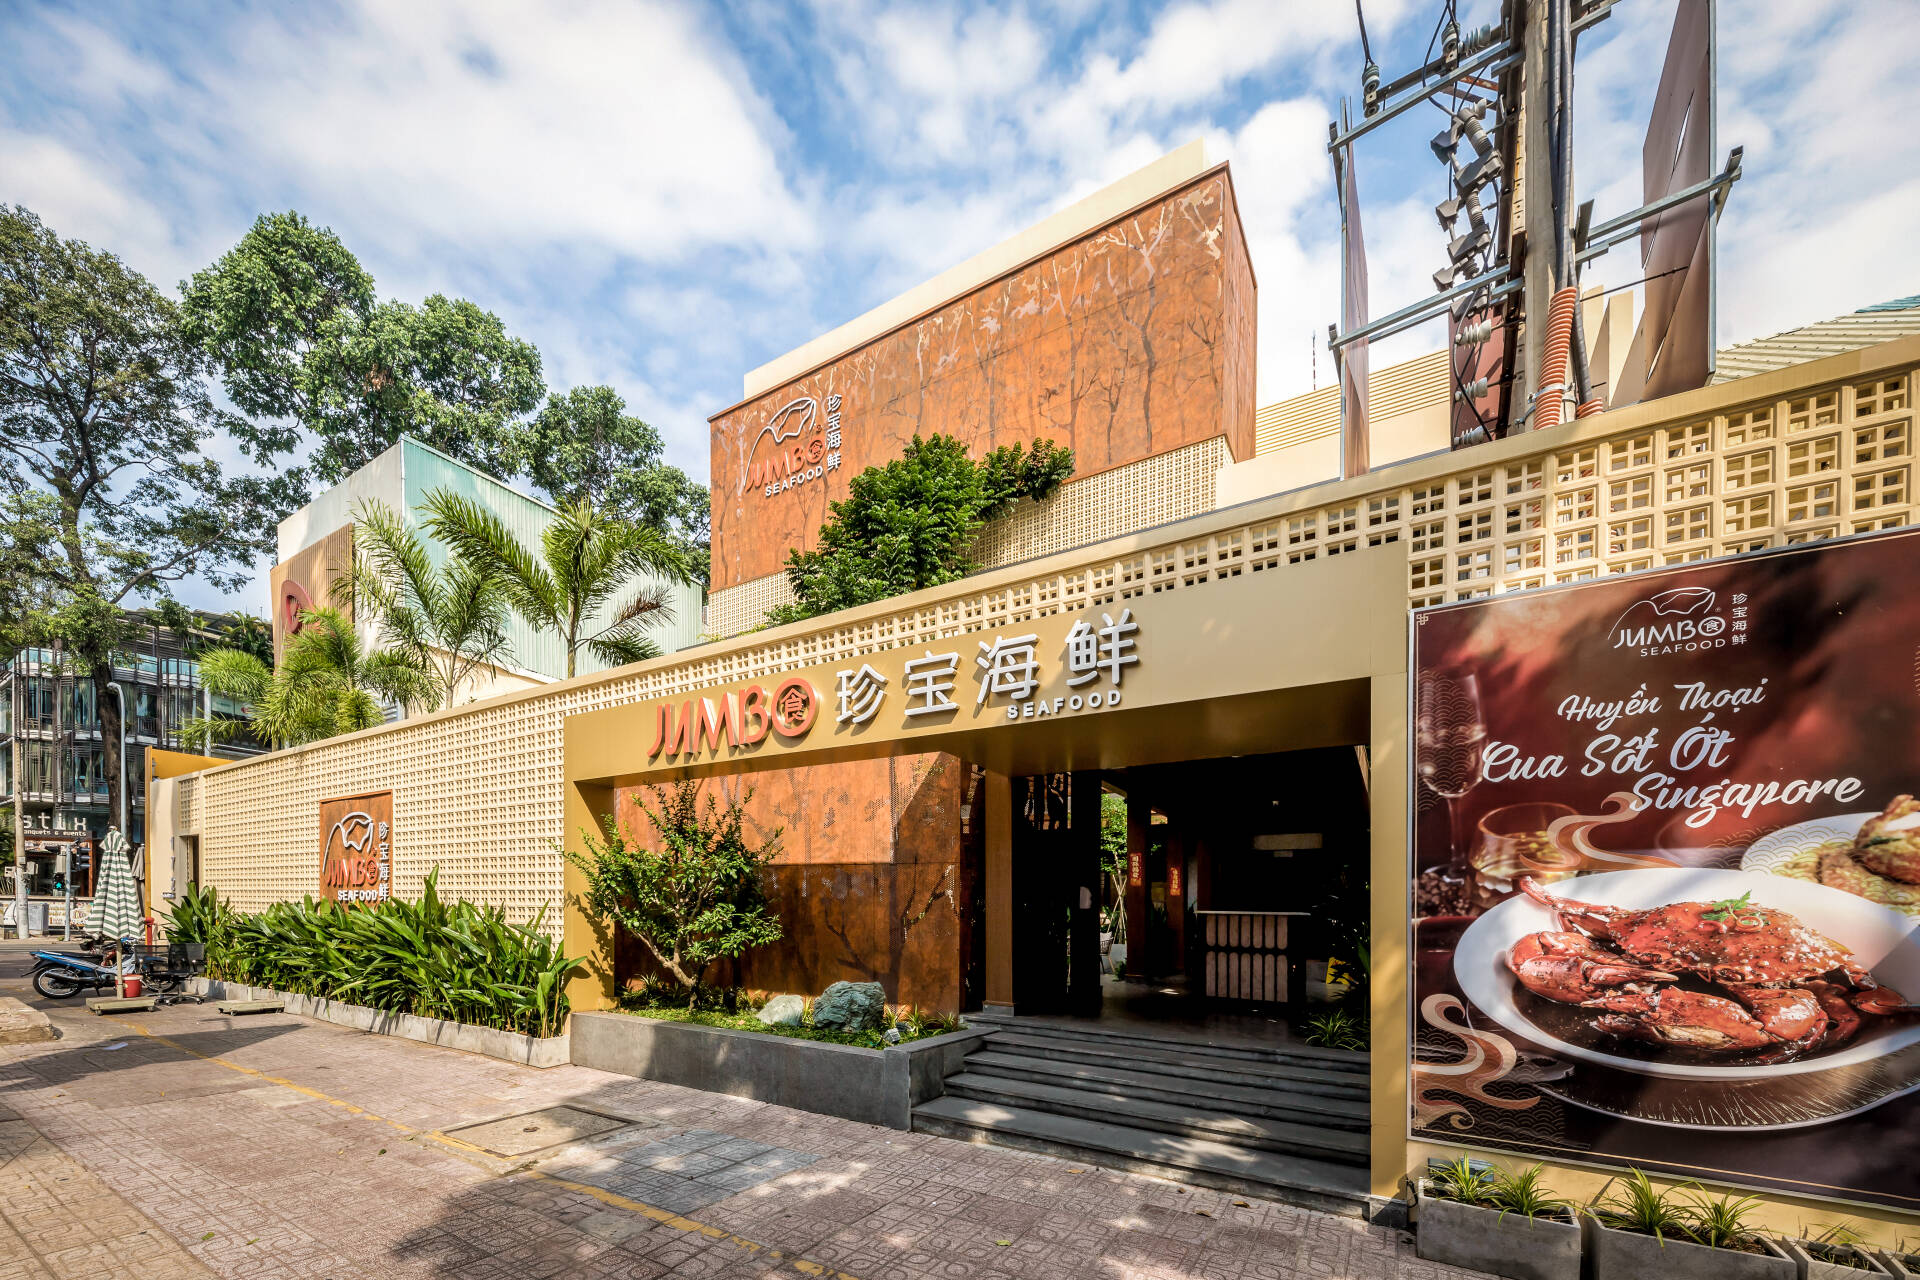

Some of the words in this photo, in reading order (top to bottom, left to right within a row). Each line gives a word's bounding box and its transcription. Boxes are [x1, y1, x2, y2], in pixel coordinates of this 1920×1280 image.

[827, 394, 843, 472] 珍宝海鲜
[746, 439, 826, 493] JUMBO
[765, 465, 824, 497] SEAFOOD
[1613, 616, 1726, 649] JUMBO
[1731, 593, 1748, 646] 珍宝海鲜
[1640, 638, 1726, 657] SEAFOOD
[648, 677, 816, 757] JUMBO
[836, 608, 1139, 723] 珍宝海鲜
[1007, 689, 1121, 719] SEAFOOD
[1557, 682, 1662, 731] Huyền
[1673, 677, 1768, 713] Thoại
[1482, 741, 1568, 783] Cua
[1581, 727, 1659, 777] Sốt
[1670, 711, 1736, 771] Ớt
[1628, 772, 1865, 829] Singapore
[338, 890, 378, 901] SEAFOOD
